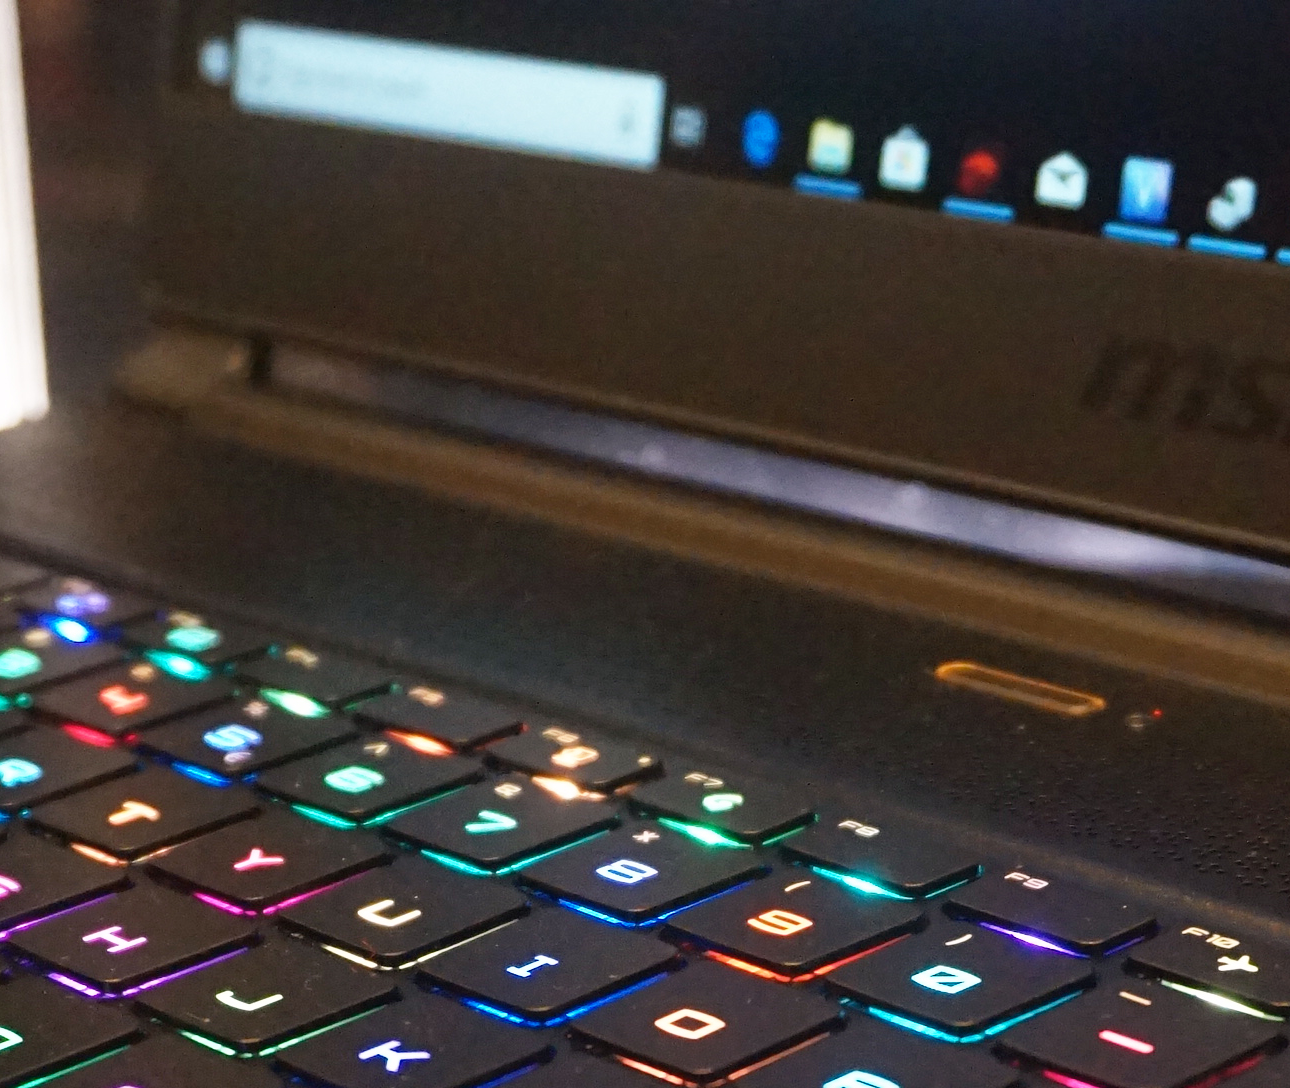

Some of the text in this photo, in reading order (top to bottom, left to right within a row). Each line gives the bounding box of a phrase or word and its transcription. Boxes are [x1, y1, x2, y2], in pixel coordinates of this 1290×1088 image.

[201, 722, 264, 754] 5
[683, 770, 725, 790] F7
[106, 798, 162, 828] T
[463, 808, 519, 835] 7
[836, 818, 881, 839] F8
[231, 845, 287, 874] Y
[593, 857, 660, 888] 8
[1002, 870, 1050, 891] F9
[355, 897, 423, 930] U
[745, 907, 815, 939] 9
[80, 924, 149, 955] H
[1180, 925, 1242, 951] F10
[504, 952, 561, 980] I
[213, 988, 285, 1013] J
[652, 1006, 728, 1042] O
[356, 1038, 433, 1075] K
